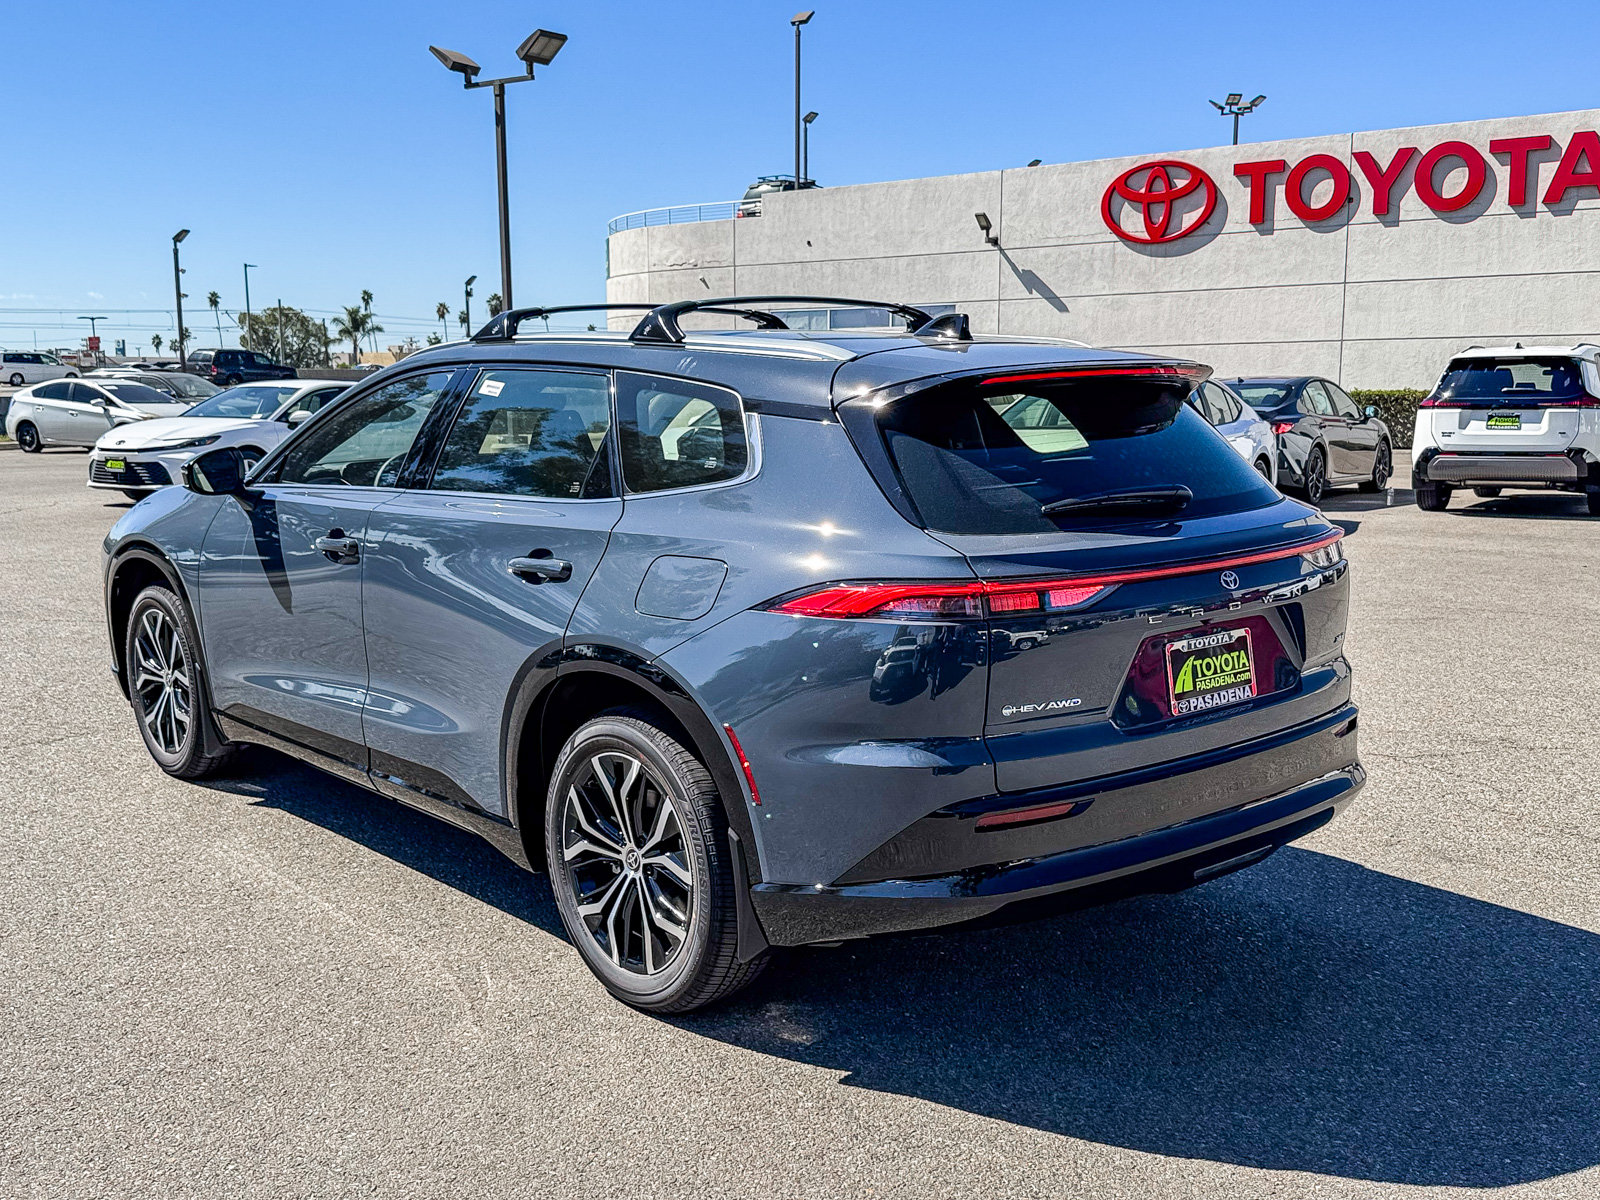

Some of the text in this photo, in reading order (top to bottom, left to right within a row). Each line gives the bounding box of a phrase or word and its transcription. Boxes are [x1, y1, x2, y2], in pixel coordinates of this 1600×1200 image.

[1234, 131, 1600, 224] TOYOTA
[1149, 587, 1301, 624] CROWN
[1189, 634, 1230, 649] TOYOTA
[1193, 650, 1249, 677] TOYOTA
[1196, 671, 1251, 691] PASADENA.com
[1189, 685, 1253, 711] PASADENA
